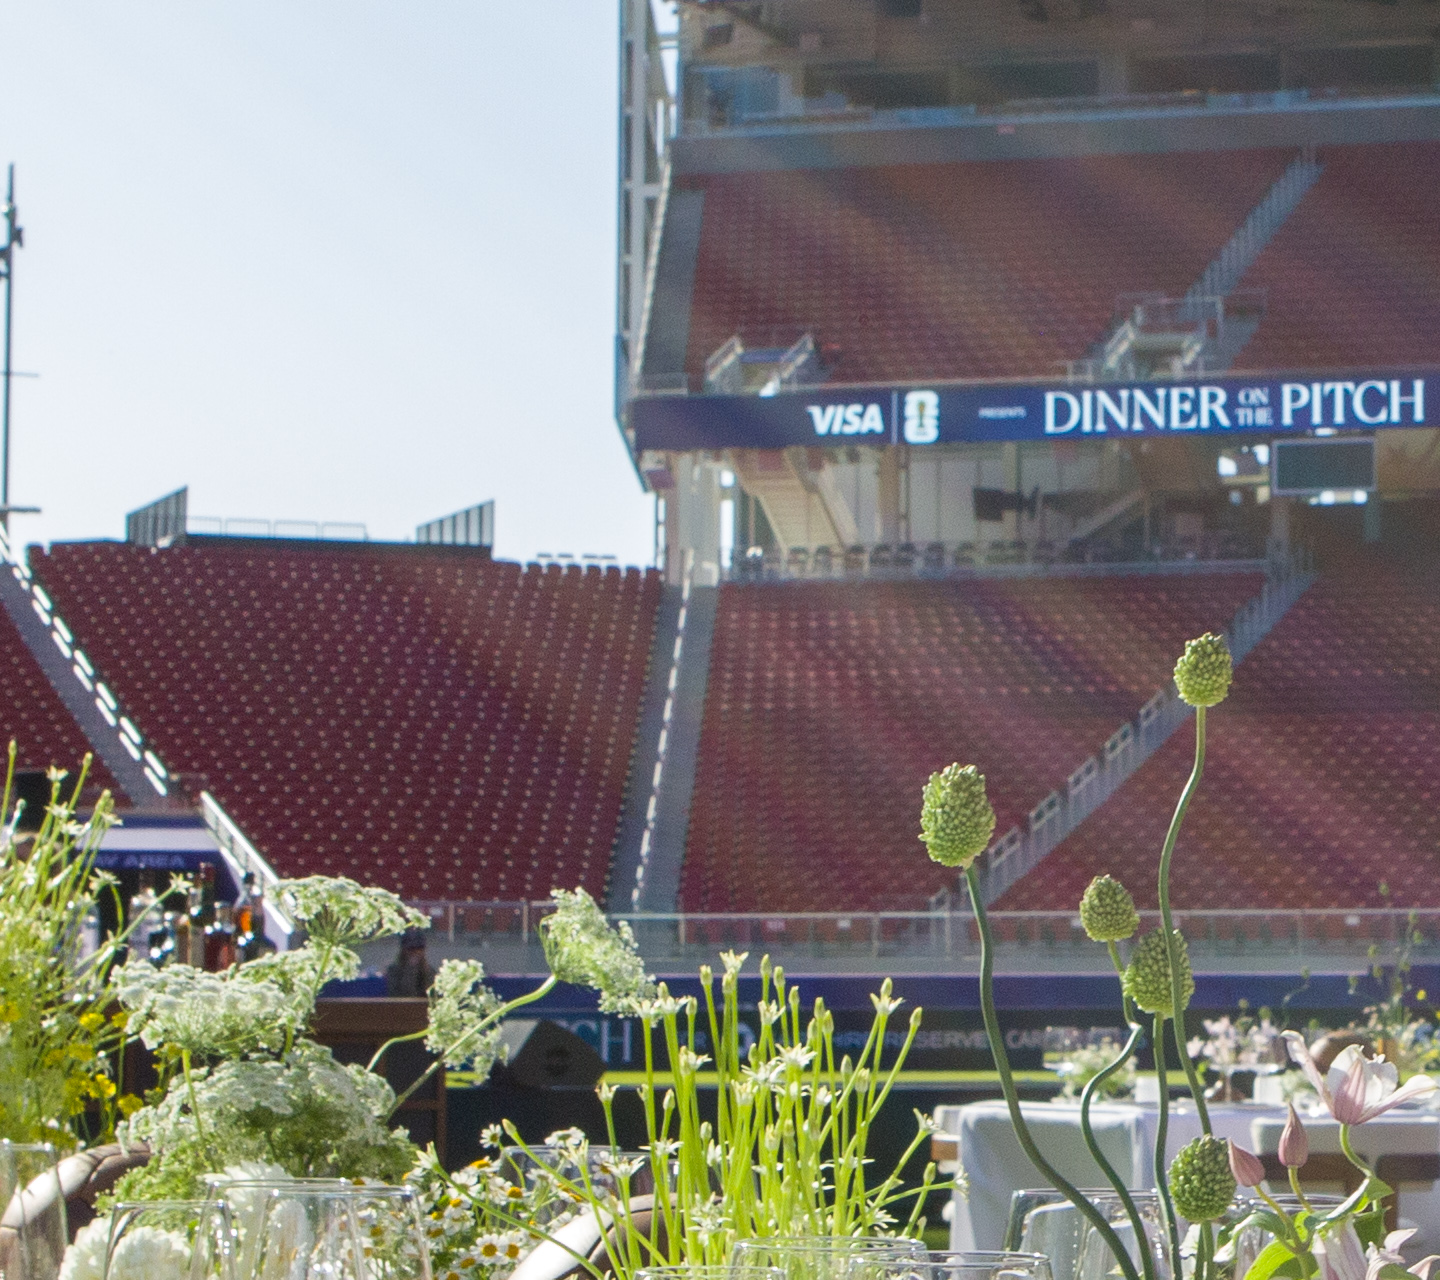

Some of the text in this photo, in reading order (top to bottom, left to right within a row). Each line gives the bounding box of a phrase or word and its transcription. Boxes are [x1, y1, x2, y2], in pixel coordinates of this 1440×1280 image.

[806, 403, 884, 435] VISA
[1044, 387, 1231, 435] DINNER
[1238, 387, 1269, 406] ON
[1281, 379, 1425, 425] PITCH
